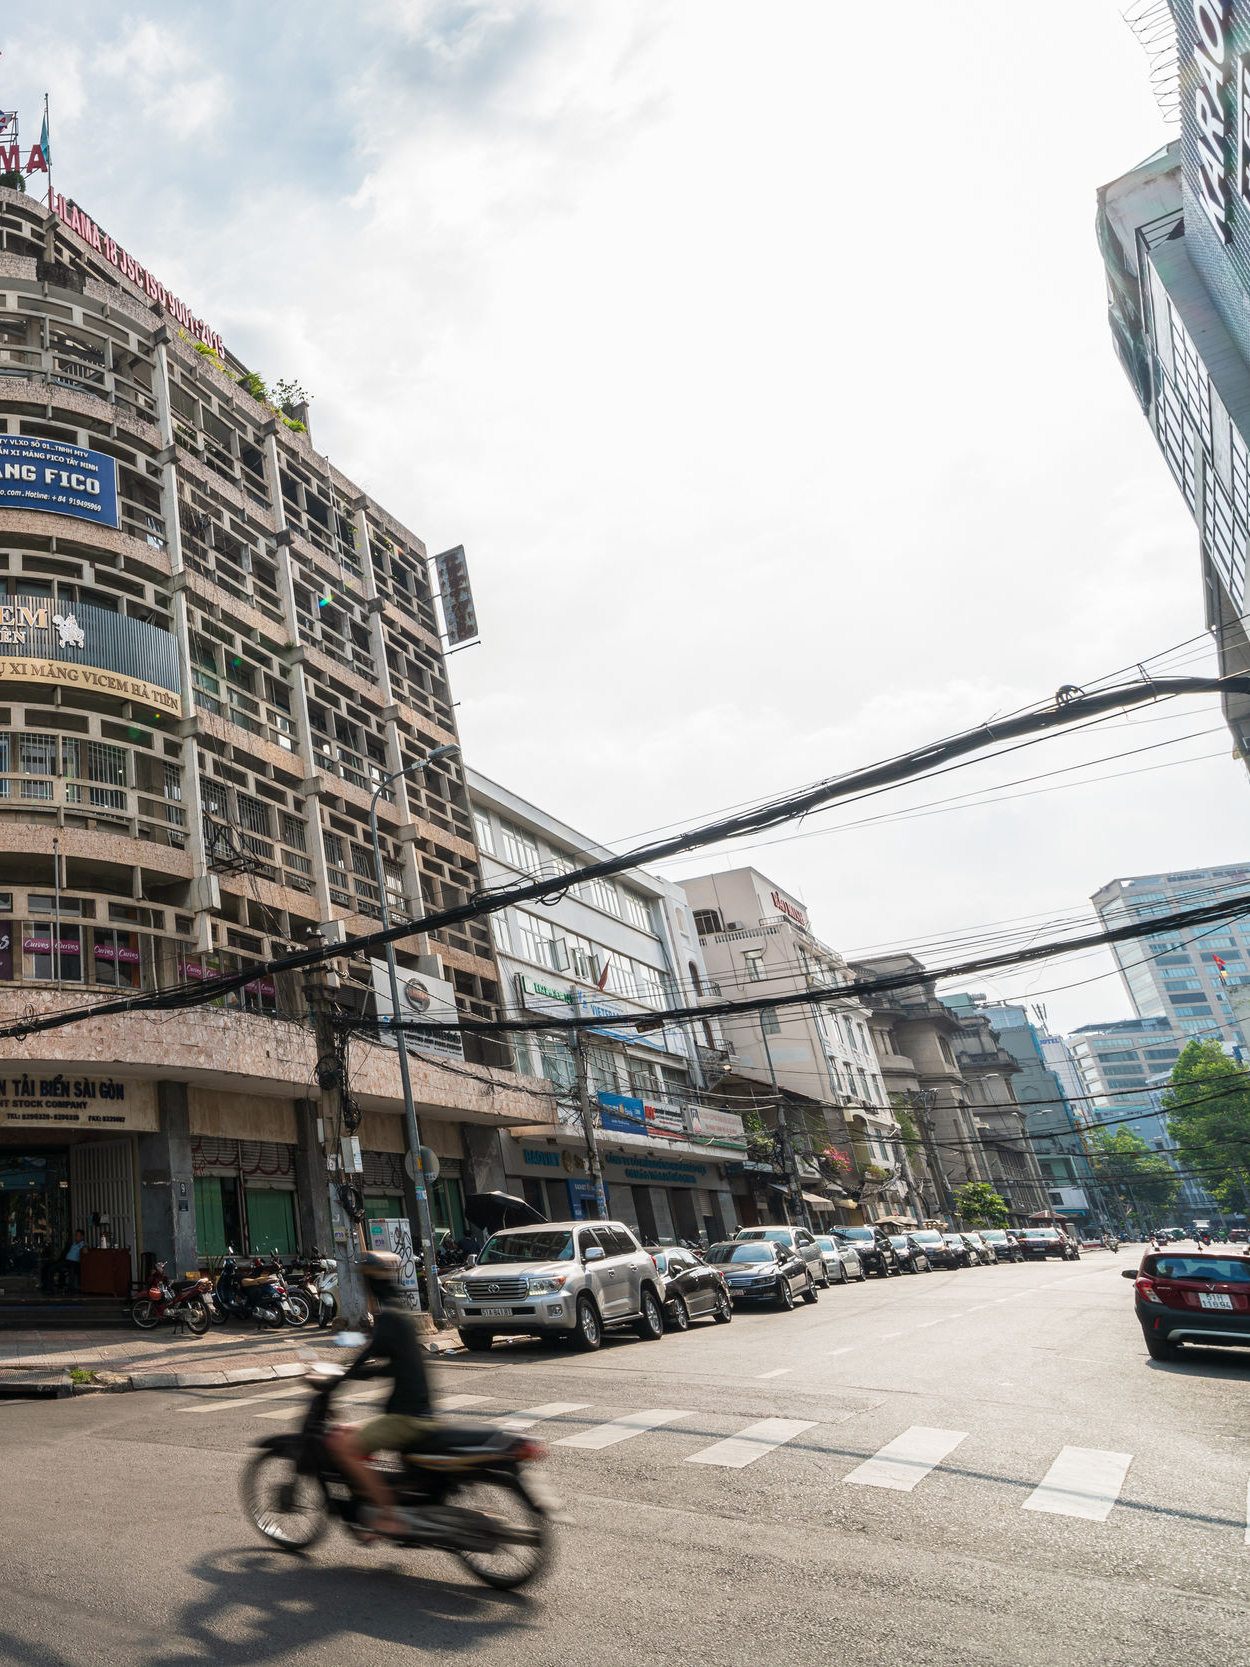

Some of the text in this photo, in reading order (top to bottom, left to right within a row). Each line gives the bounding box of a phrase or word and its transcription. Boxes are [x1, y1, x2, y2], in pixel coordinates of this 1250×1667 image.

[1193, 0, 1226, 245] KARAO
[48, 186, 102, 254] LILAMA
[104, 234, 118, 266] 18
[119, 248, 143, 288] JSC
[143, 269, 166, 308] ISO
[10, 439, 29, 447] VLXD
[46, 454, 65, 463] FICO
[80, 461, 99, 472] NINH
[45, 468, 100, 495] FICO
[10, 662, 28, 675] XI
[31, 663, 79, 681] MĂNG
[82, 671, 129, 693] VICEM
[131, 681, 150, 699] HÀ
[151, 689, 179, 711] TIÊN
[12, 1073, 35, 1096] TẢI
[39, 1074, 70, 1098] BIỂN
[74, 1077, 96, 1099] SÀI
[99, 1078, 124, 1100] GÒN
[12, 1100, 43, 1108] STOCK
[46, 1101, 88, 1109] COMPANY
